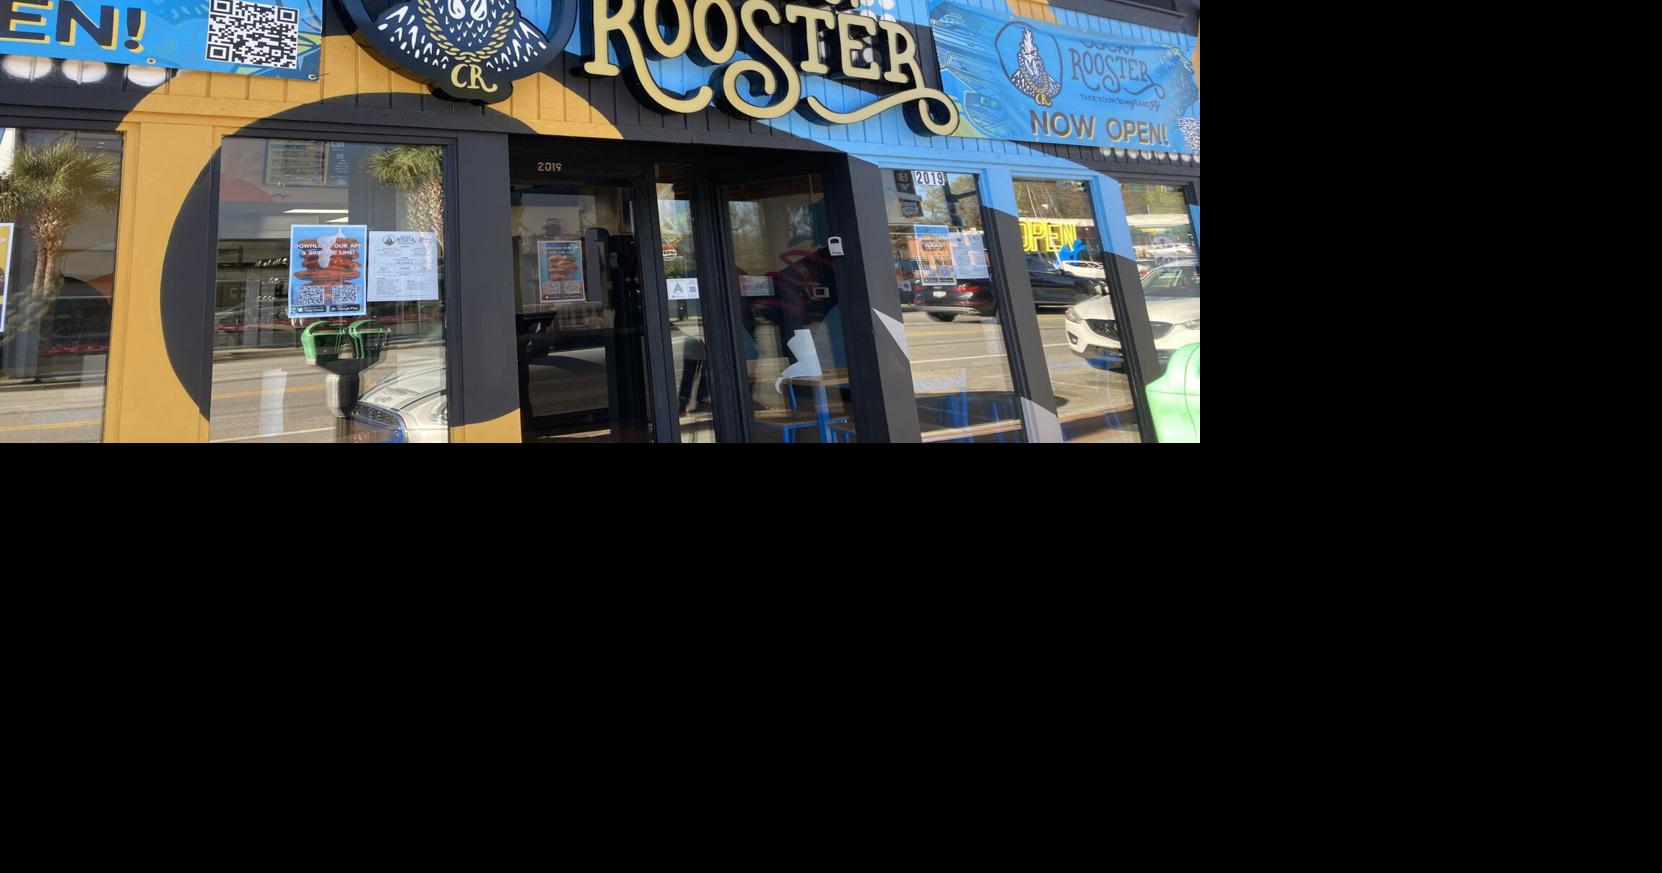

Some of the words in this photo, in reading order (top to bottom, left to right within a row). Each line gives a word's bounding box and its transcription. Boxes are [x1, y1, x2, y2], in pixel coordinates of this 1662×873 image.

[451, 63, 498, 92] CR
[584, 0, 959, 136] ROOSTER
[1068, 48, 1165, 99] ROOSTER
[1029, 109, 1096, 140] NOW
[1106, 117, 1170, 147] OPEN!
[537, 162, 562, 172] 2019
[916, 171, 944, 185] 2019
